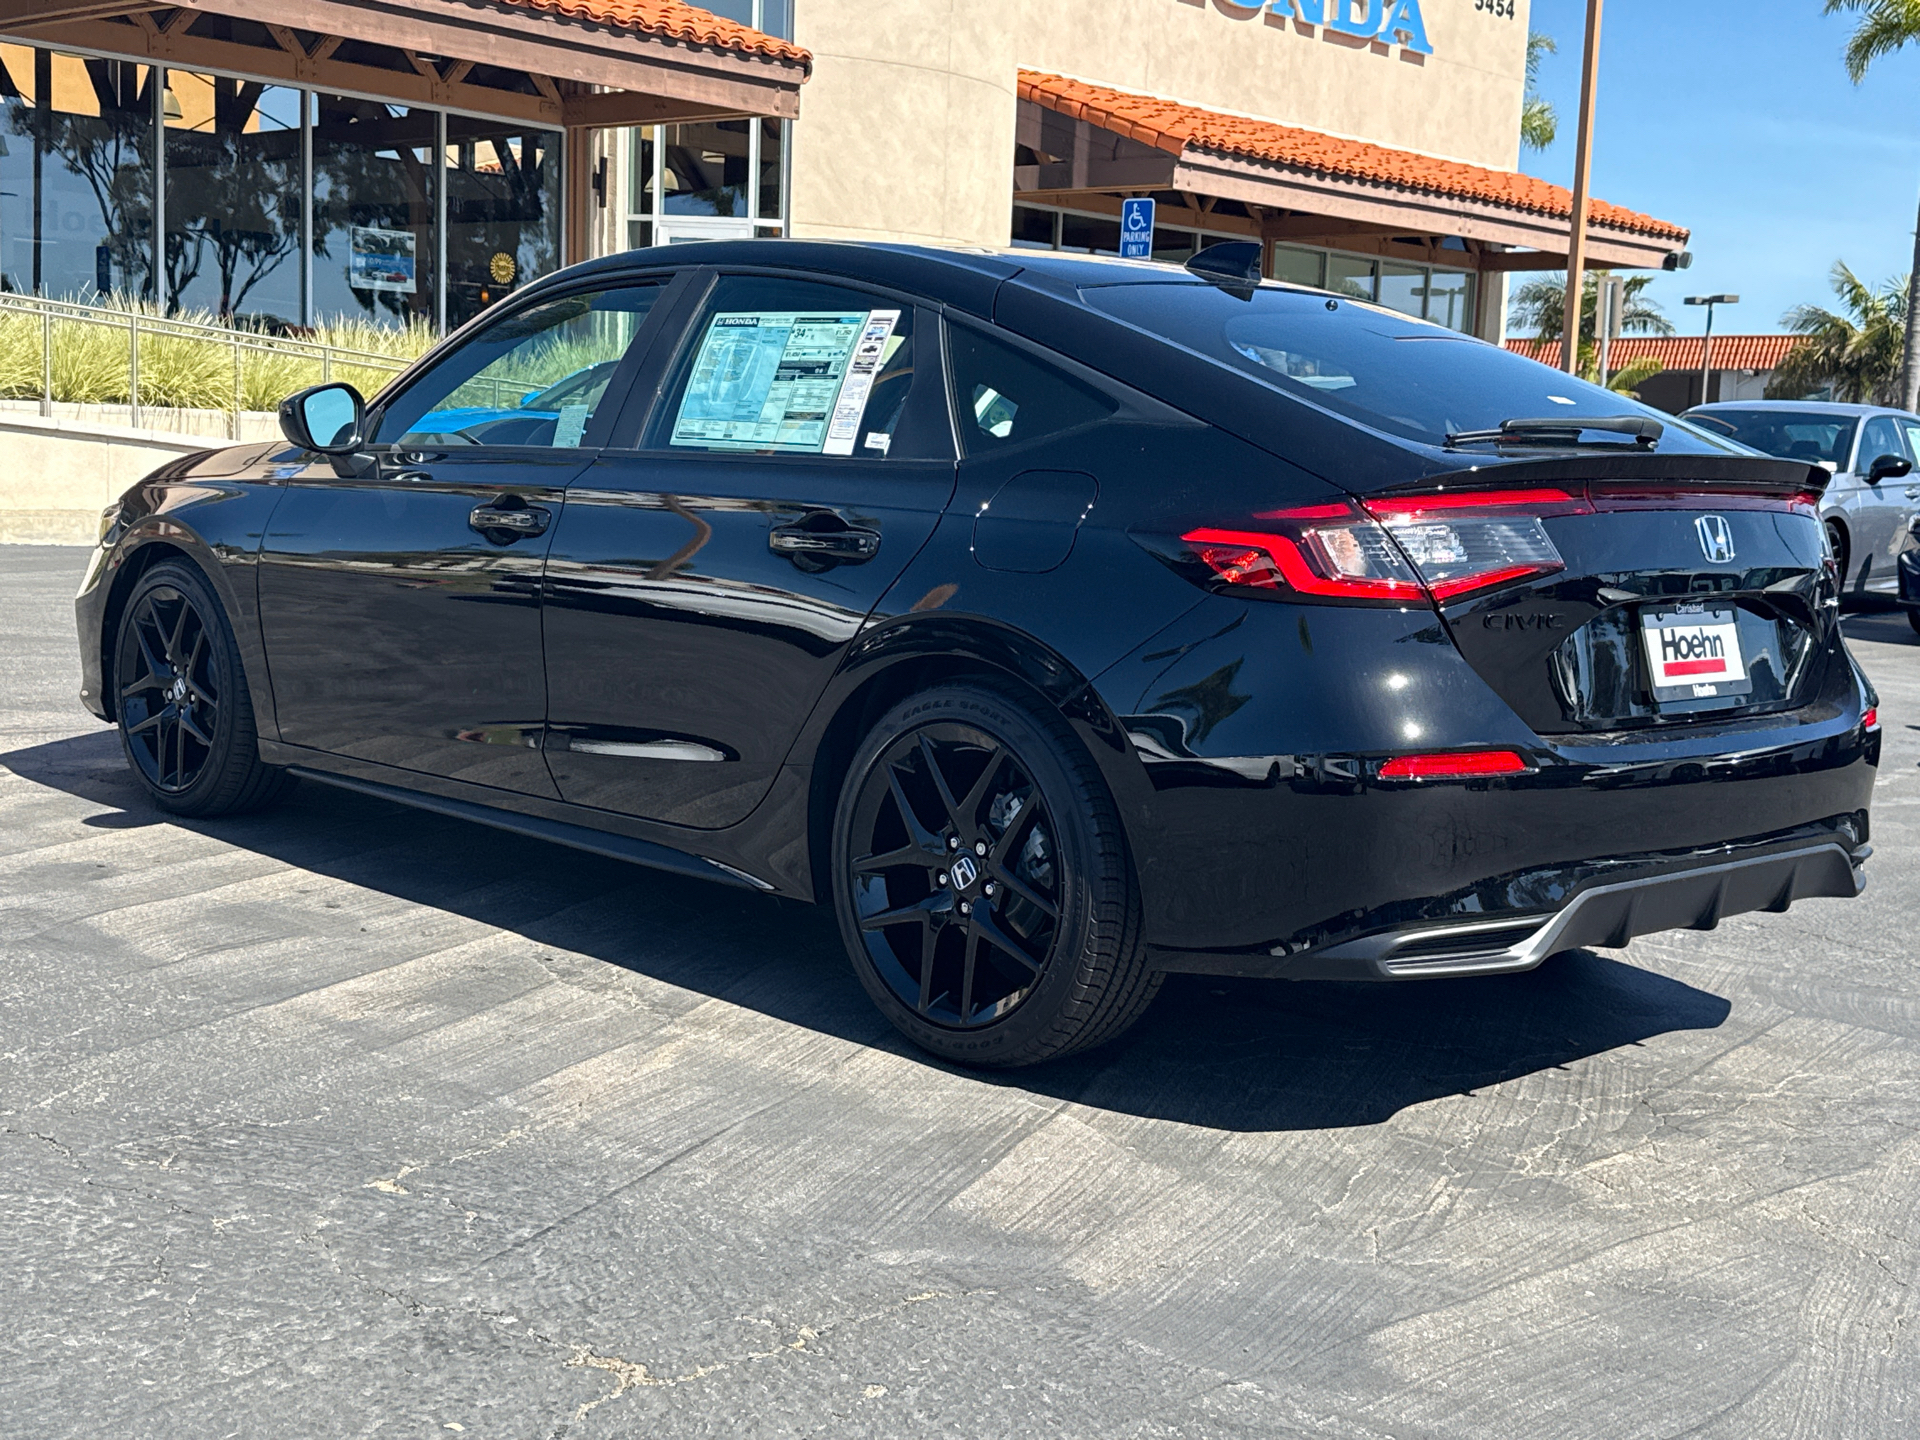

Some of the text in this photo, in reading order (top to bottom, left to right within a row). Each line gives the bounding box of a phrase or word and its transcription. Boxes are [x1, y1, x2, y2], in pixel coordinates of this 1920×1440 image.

[1475, 0, 1515, 21] 5454
[1123, 231, 1150, 242] PARKING
[1127, 243, 1145, 256] ONLY
[794, 328, 806, 338] 34
[1676, 603, 1704, 614] Carlsbad
[1483, 612, 1566, 631] CIVIC
[1660, 627, 1725, 661] Hoehn
[902, 700, 954, 721] EAGLE
